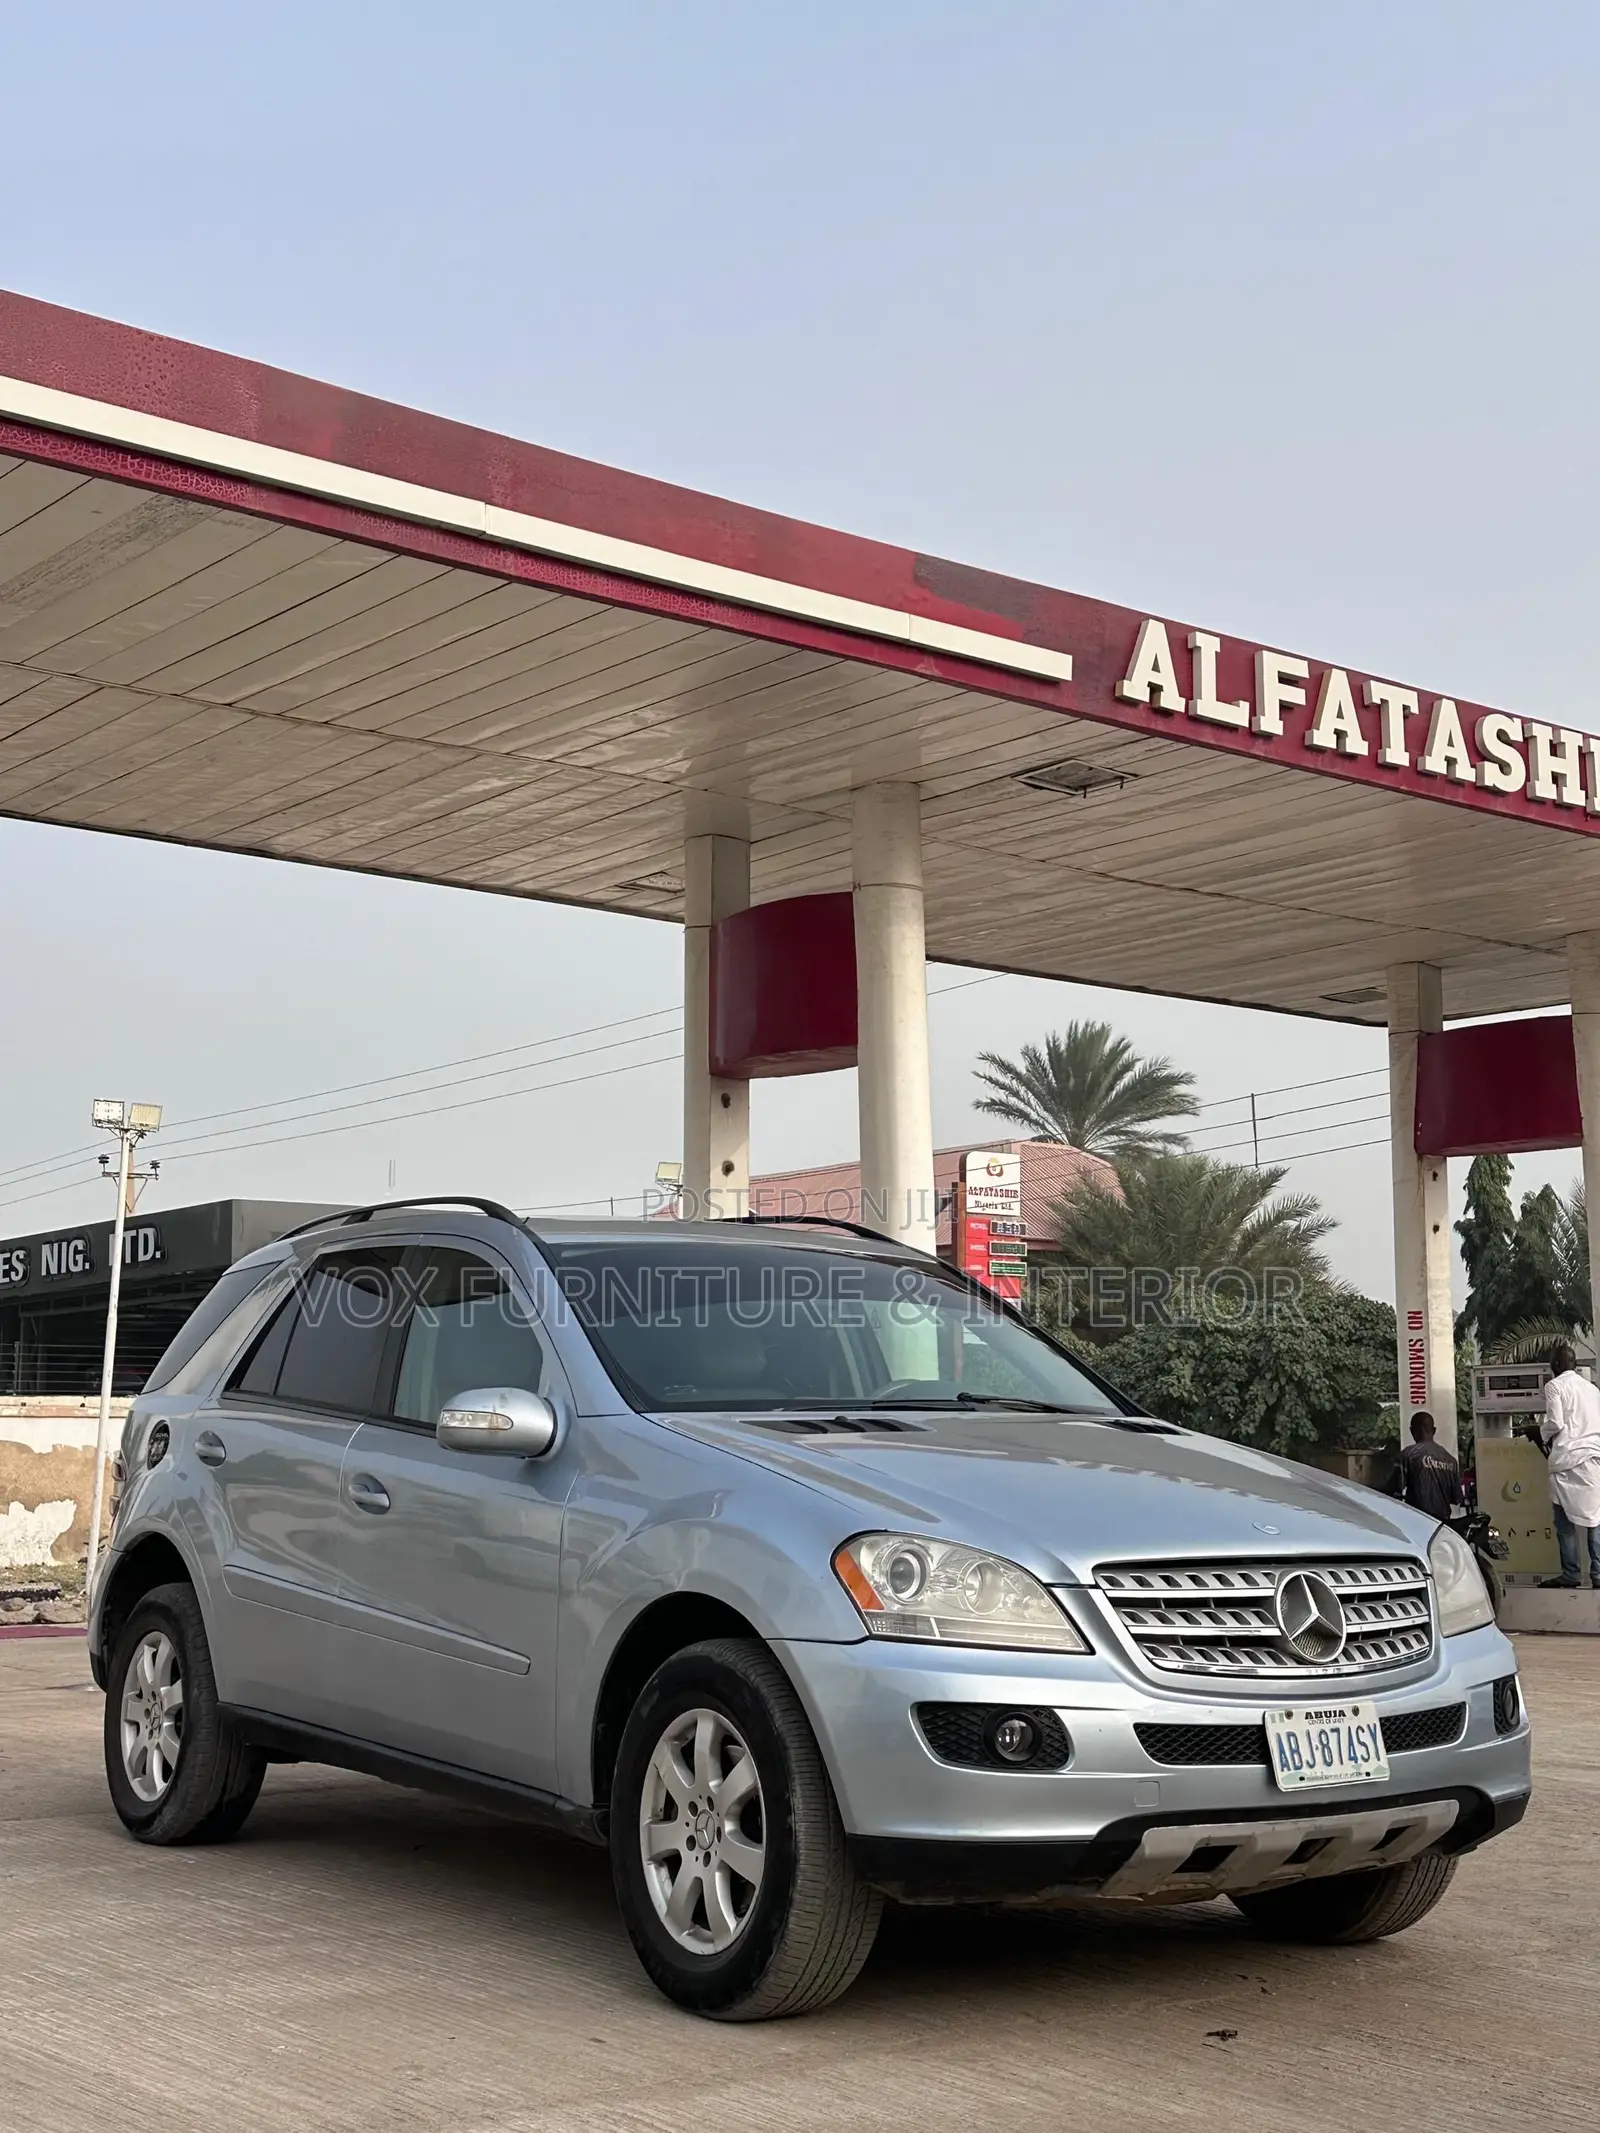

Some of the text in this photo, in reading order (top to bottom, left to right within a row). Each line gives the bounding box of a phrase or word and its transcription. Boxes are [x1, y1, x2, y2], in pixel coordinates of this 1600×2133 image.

[41, 1239, 90, 1276] NIG.
[1407, 1310, 1427, 1405] NO SMOKING
[1304, 1709, 1347, 1720] ABUJA
